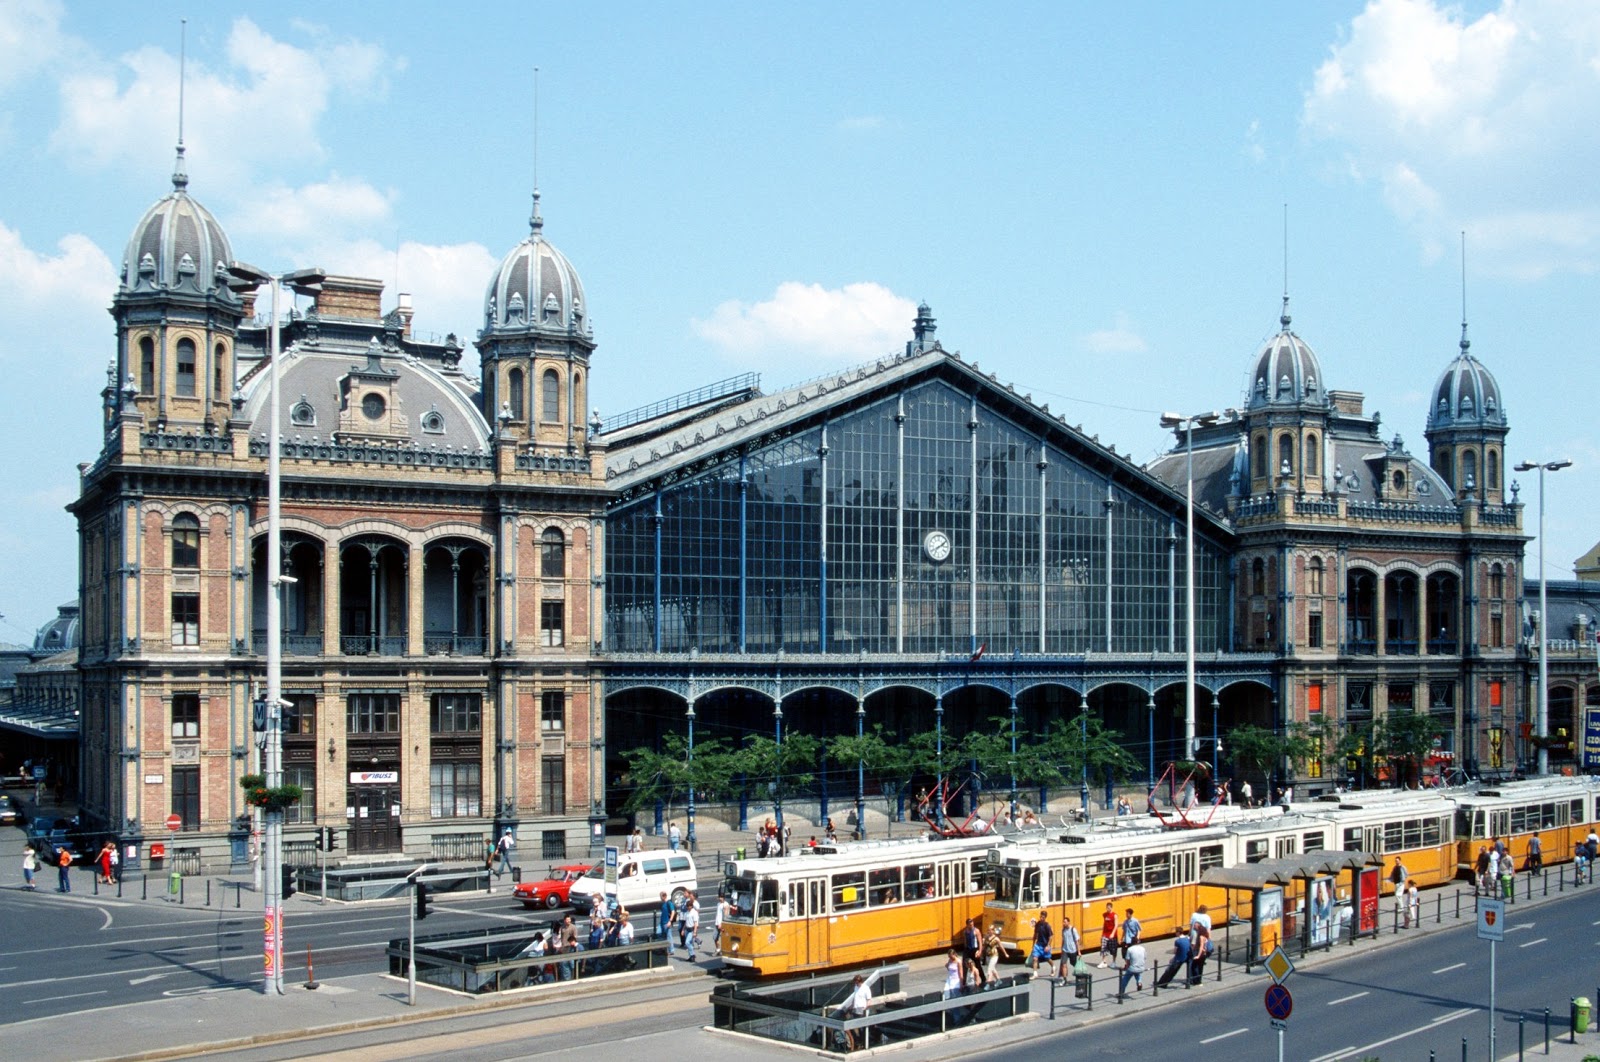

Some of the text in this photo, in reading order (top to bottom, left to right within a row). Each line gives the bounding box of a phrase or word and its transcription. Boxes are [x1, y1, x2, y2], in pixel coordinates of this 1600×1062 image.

[255, 705, 264, 720] M
[1586, 736, 1600, 745] SZO
[991, 851, 997, 862] 6
[729, 864, 734, 875] 6
